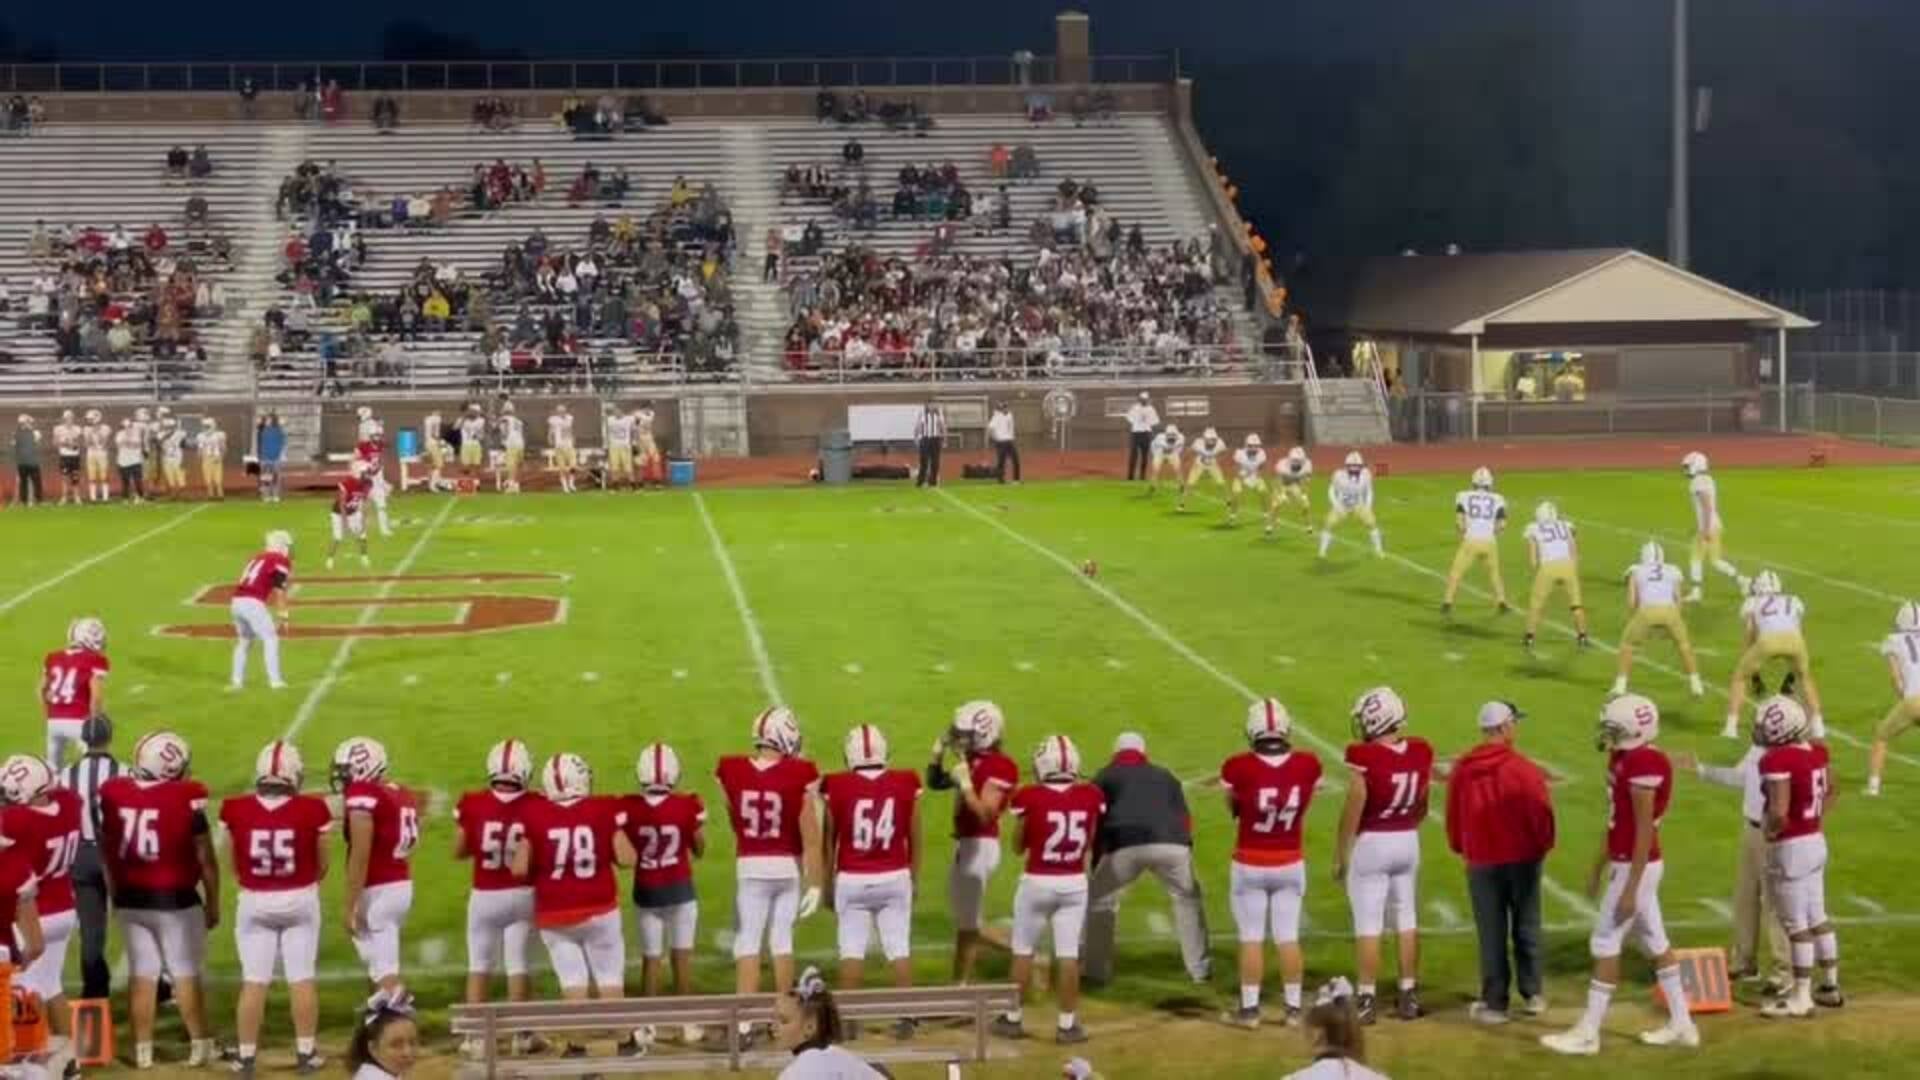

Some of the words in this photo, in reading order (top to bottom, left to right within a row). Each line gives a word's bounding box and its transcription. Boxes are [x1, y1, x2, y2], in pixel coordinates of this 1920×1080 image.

[740, 789, 783, 839] 53
[1252, 785, 1301, 833] 54
[1379, 771, 1419, 819] 71
[119, 806, 160, 862] 76
[639, 824, 681, 870] 22
[853, 797, 896, 851] 64
[1042, 811, 1088, 862] 25
[250, 829, 296, 877] 55
[547, 825, 597, 880] 78
